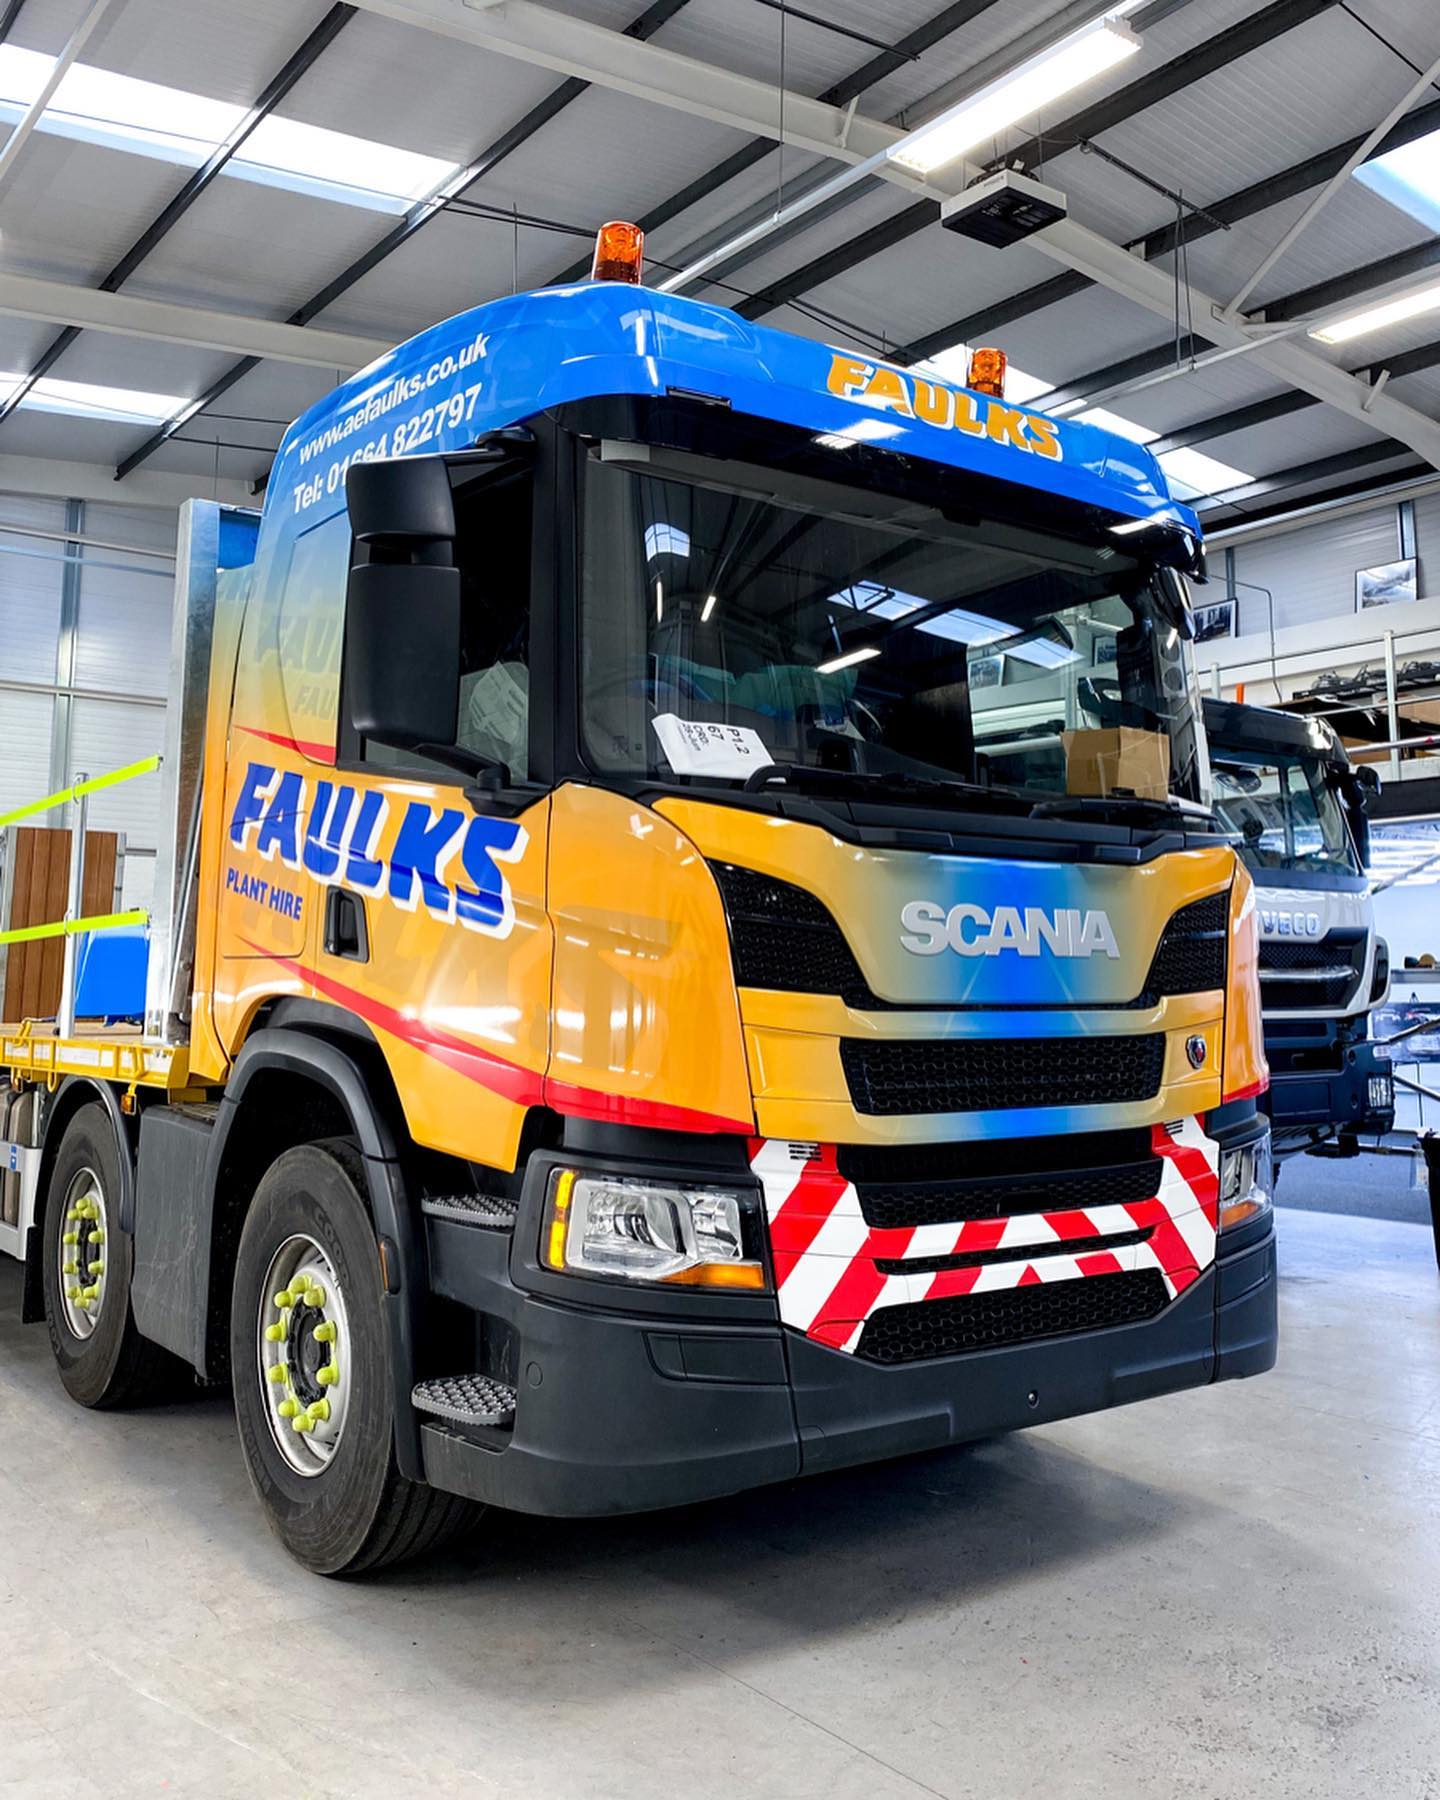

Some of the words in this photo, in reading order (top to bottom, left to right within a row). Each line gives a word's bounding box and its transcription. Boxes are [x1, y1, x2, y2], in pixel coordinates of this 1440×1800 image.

[294, 473, 323, 514] Tel:
[391, 382, 482, 457] 822797
[299, 333, 490, 465] www.aefaulks.co.uk
[826, 354, 1064, 462] FAULKS
[707, 725, 724, 740] 67
[226, 867, 268, 905] PLANT
[269, 885, 304, 921] HIRE
[230, 762, 530, 940] FAULKS
[900, 900, 1121, 960] SCANIA
